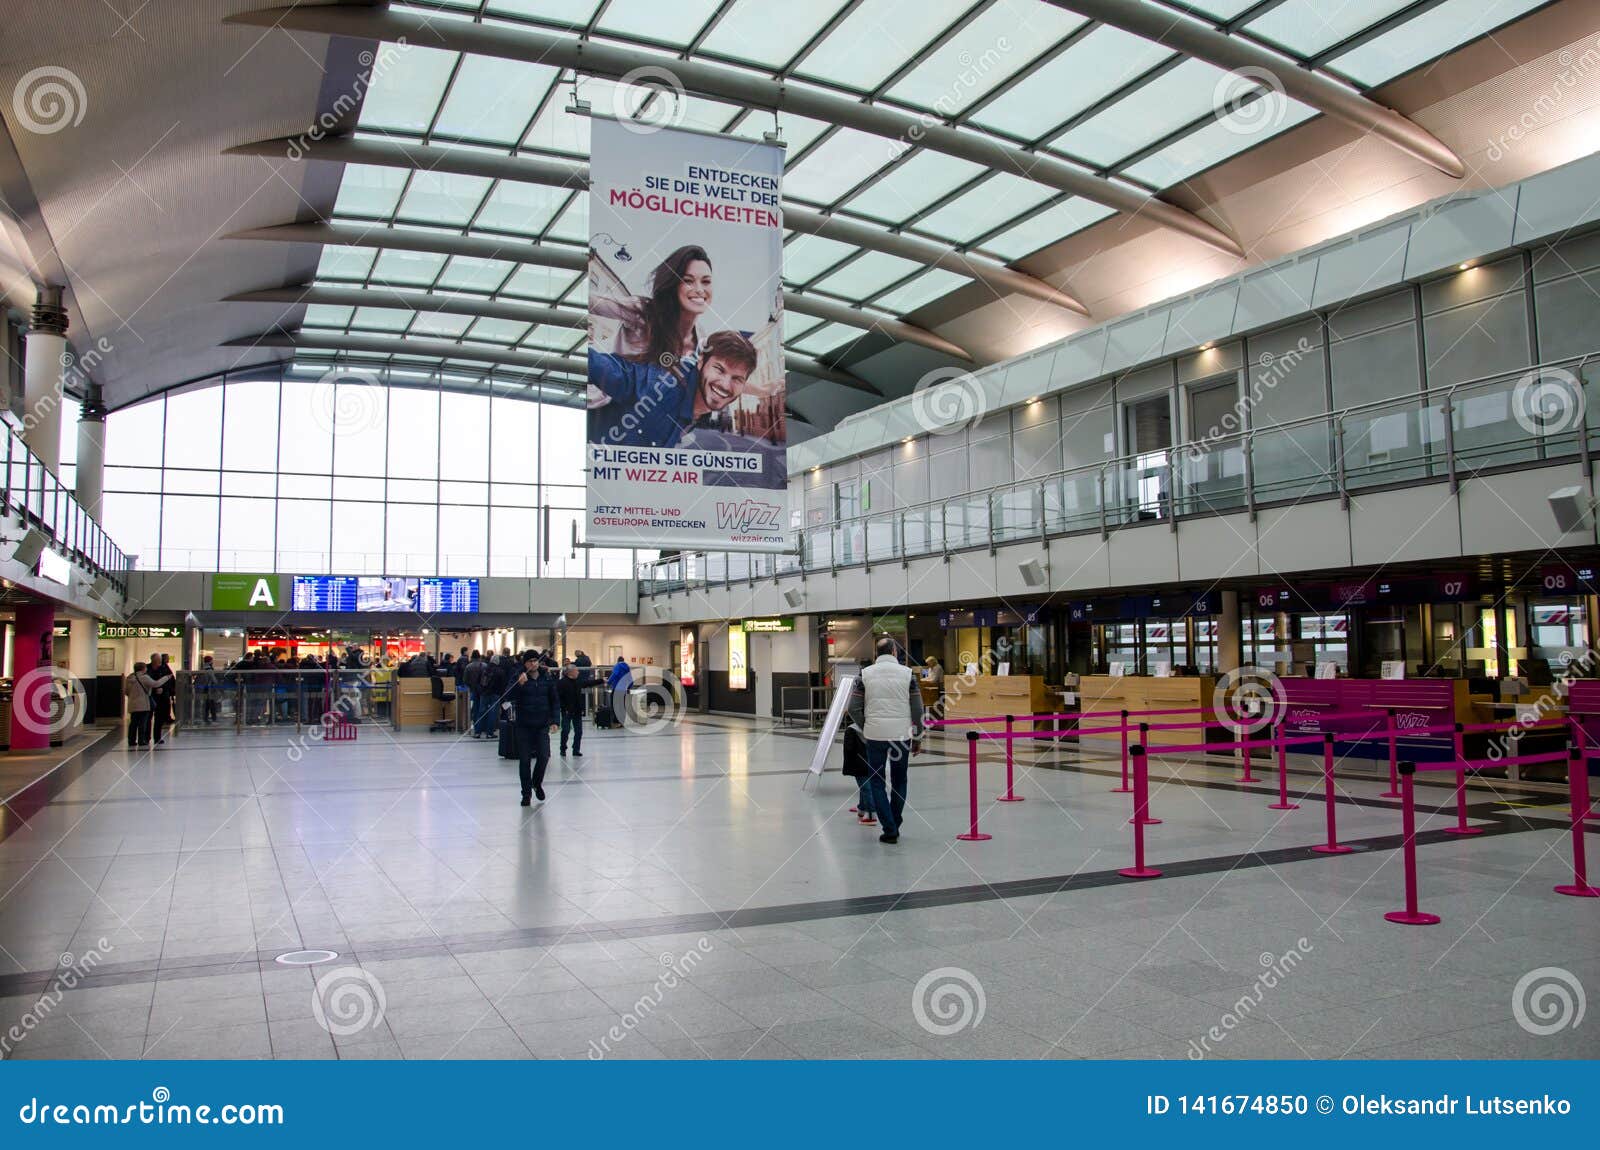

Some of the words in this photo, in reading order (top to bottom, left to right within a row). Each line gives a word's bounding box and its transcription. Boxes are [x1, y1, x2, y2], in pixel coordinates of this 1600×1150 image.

[688, 165, 779, 190] ENTDECKEN
[645, 175, 670, 191] SIE
[673, 179, 700, 195] DIE
[703, 183, 748, 202] WELT
[750, 192, 779, 207] DER
[609, 187, 779, 228] MÖGLICHKE!TEN
[593, 448, 660, 465] FLIEGEN
[663, 453, 688, 467] SIE
[691, 452, 758, 470] GÜNSTIG
[593, 466, 621, 481] MIT
[625, 468, 668, 483] WIZZ
[671, 471, 699, 485] AIR
[593, 505, 622, 515] JETZT
[624, 506, 660, 516] MITTEL-
[660, 508, 681, 517] UND
[593, 517, 650, 528] OSTEUROPA
[651, 519, 706, 529] ENTDECKEN
[730, 534, 784, 544] wizzair.com
[1443, 581, 1463, 596] 07
[1544, 574, 1567, 590] 08
[248, 577, 275, 607] A
[1196, 601, 1207, 612] 05
[1259, 594, 1275, 607] 06
[1072, 609, 1082, 619] 04
